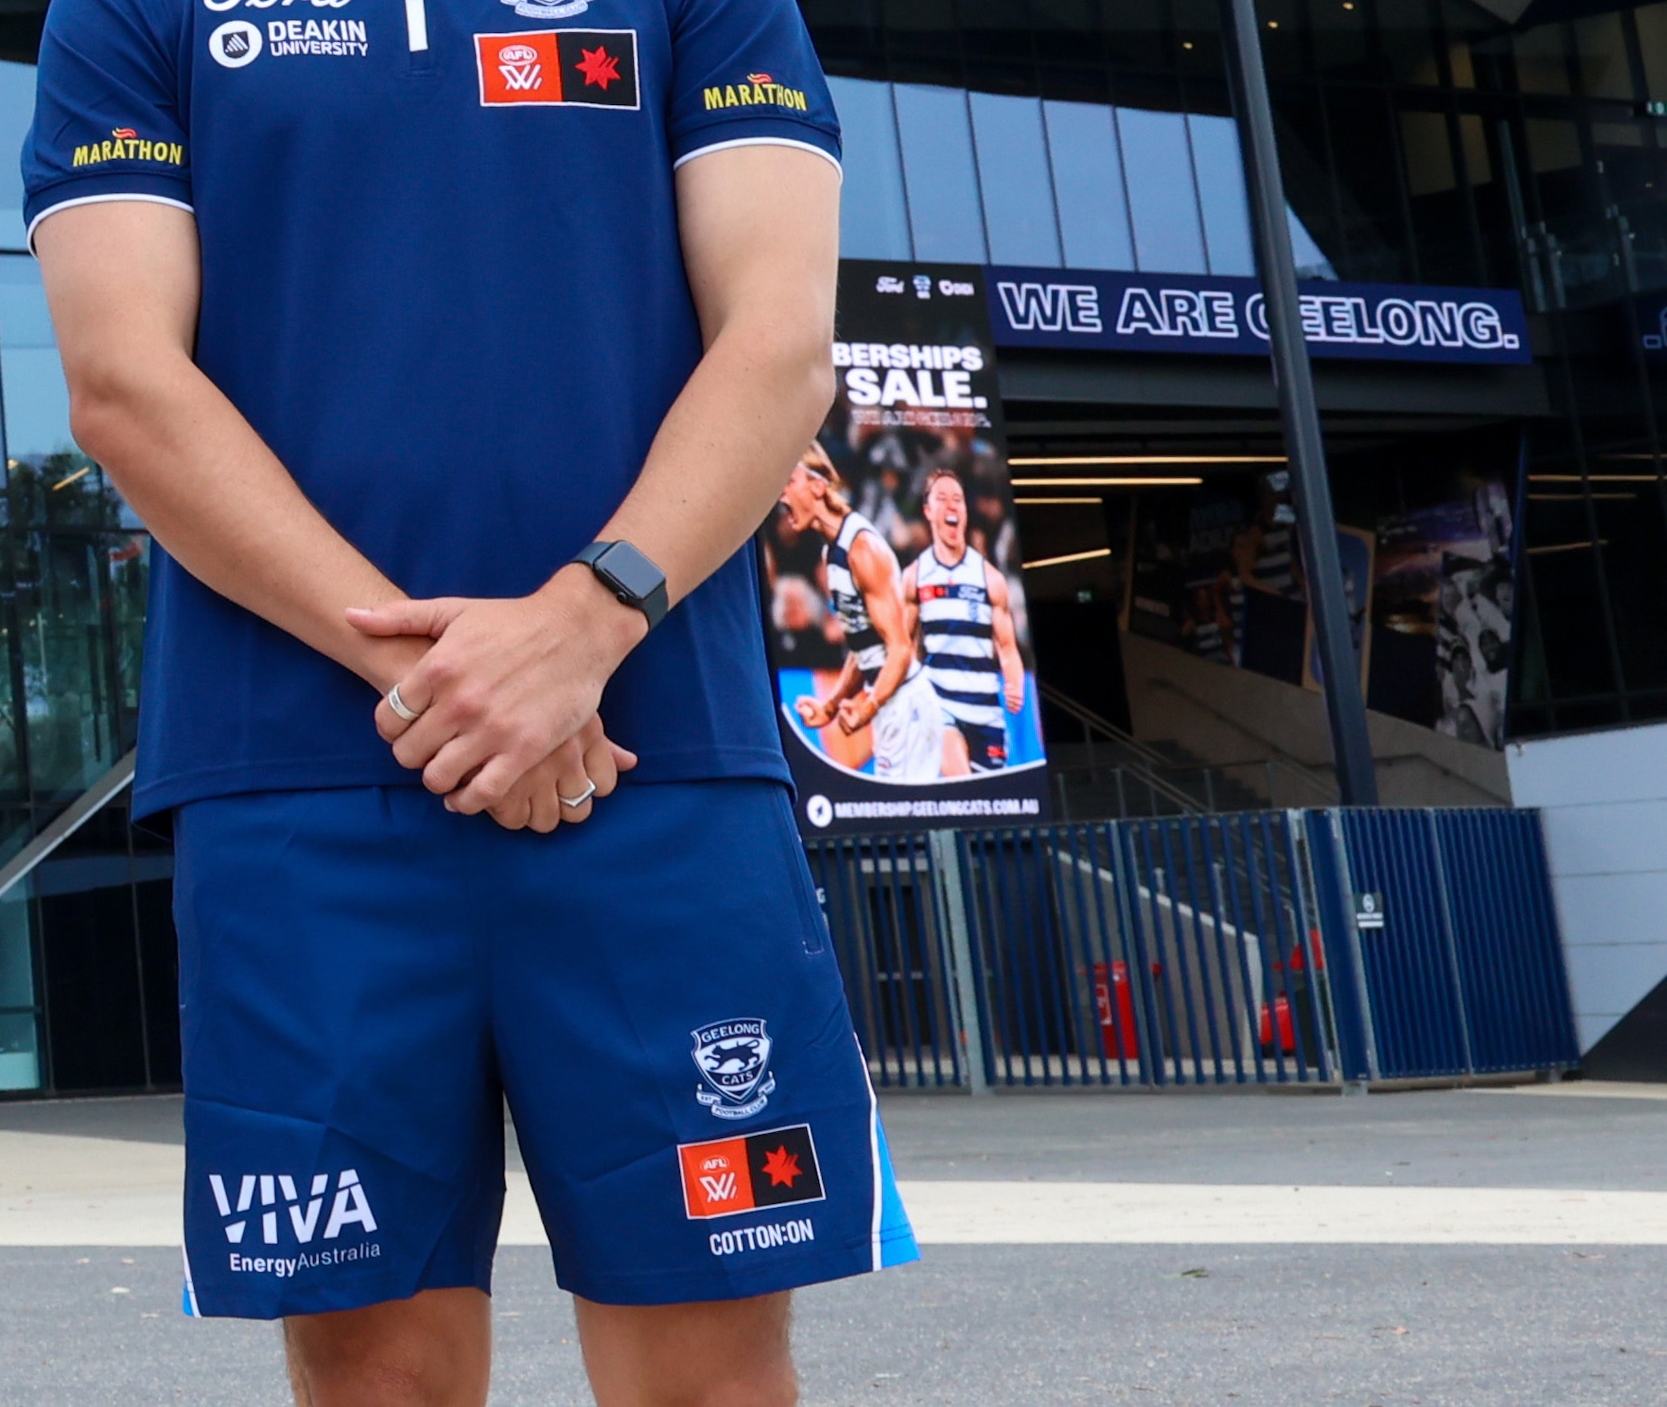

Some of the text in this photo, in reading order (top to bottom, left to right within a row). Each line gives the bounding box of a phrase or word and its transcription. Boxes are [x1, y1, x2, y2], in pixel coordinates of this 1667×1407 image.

[269, 20, 366, 41] DEAKIN
[270, 41, 368, 57] UNIVERSITY
[504, 51, 533, 60] AFL
[704, 83, 807, 111] MARATHON
[72, 139, 183, 167] MARATHON
[997, 282, 1102, 333] WE
[1117, 288, 1238, 338] ARE
[831, 342, 983, 371] BERSHIPS
[845, 368, 987, 408] SALE.
[701, 1023, 760, 1044] GEELONG
[721, 1071, 754, 1085] CATS
[703, 1159, 727, 1168] AFL
[208, 1168, 378, 1244] VIVA
[709, 1219, 814, 1256] COTTON:ON
[229, 1242, 381, 1277] EnergyAustralia
